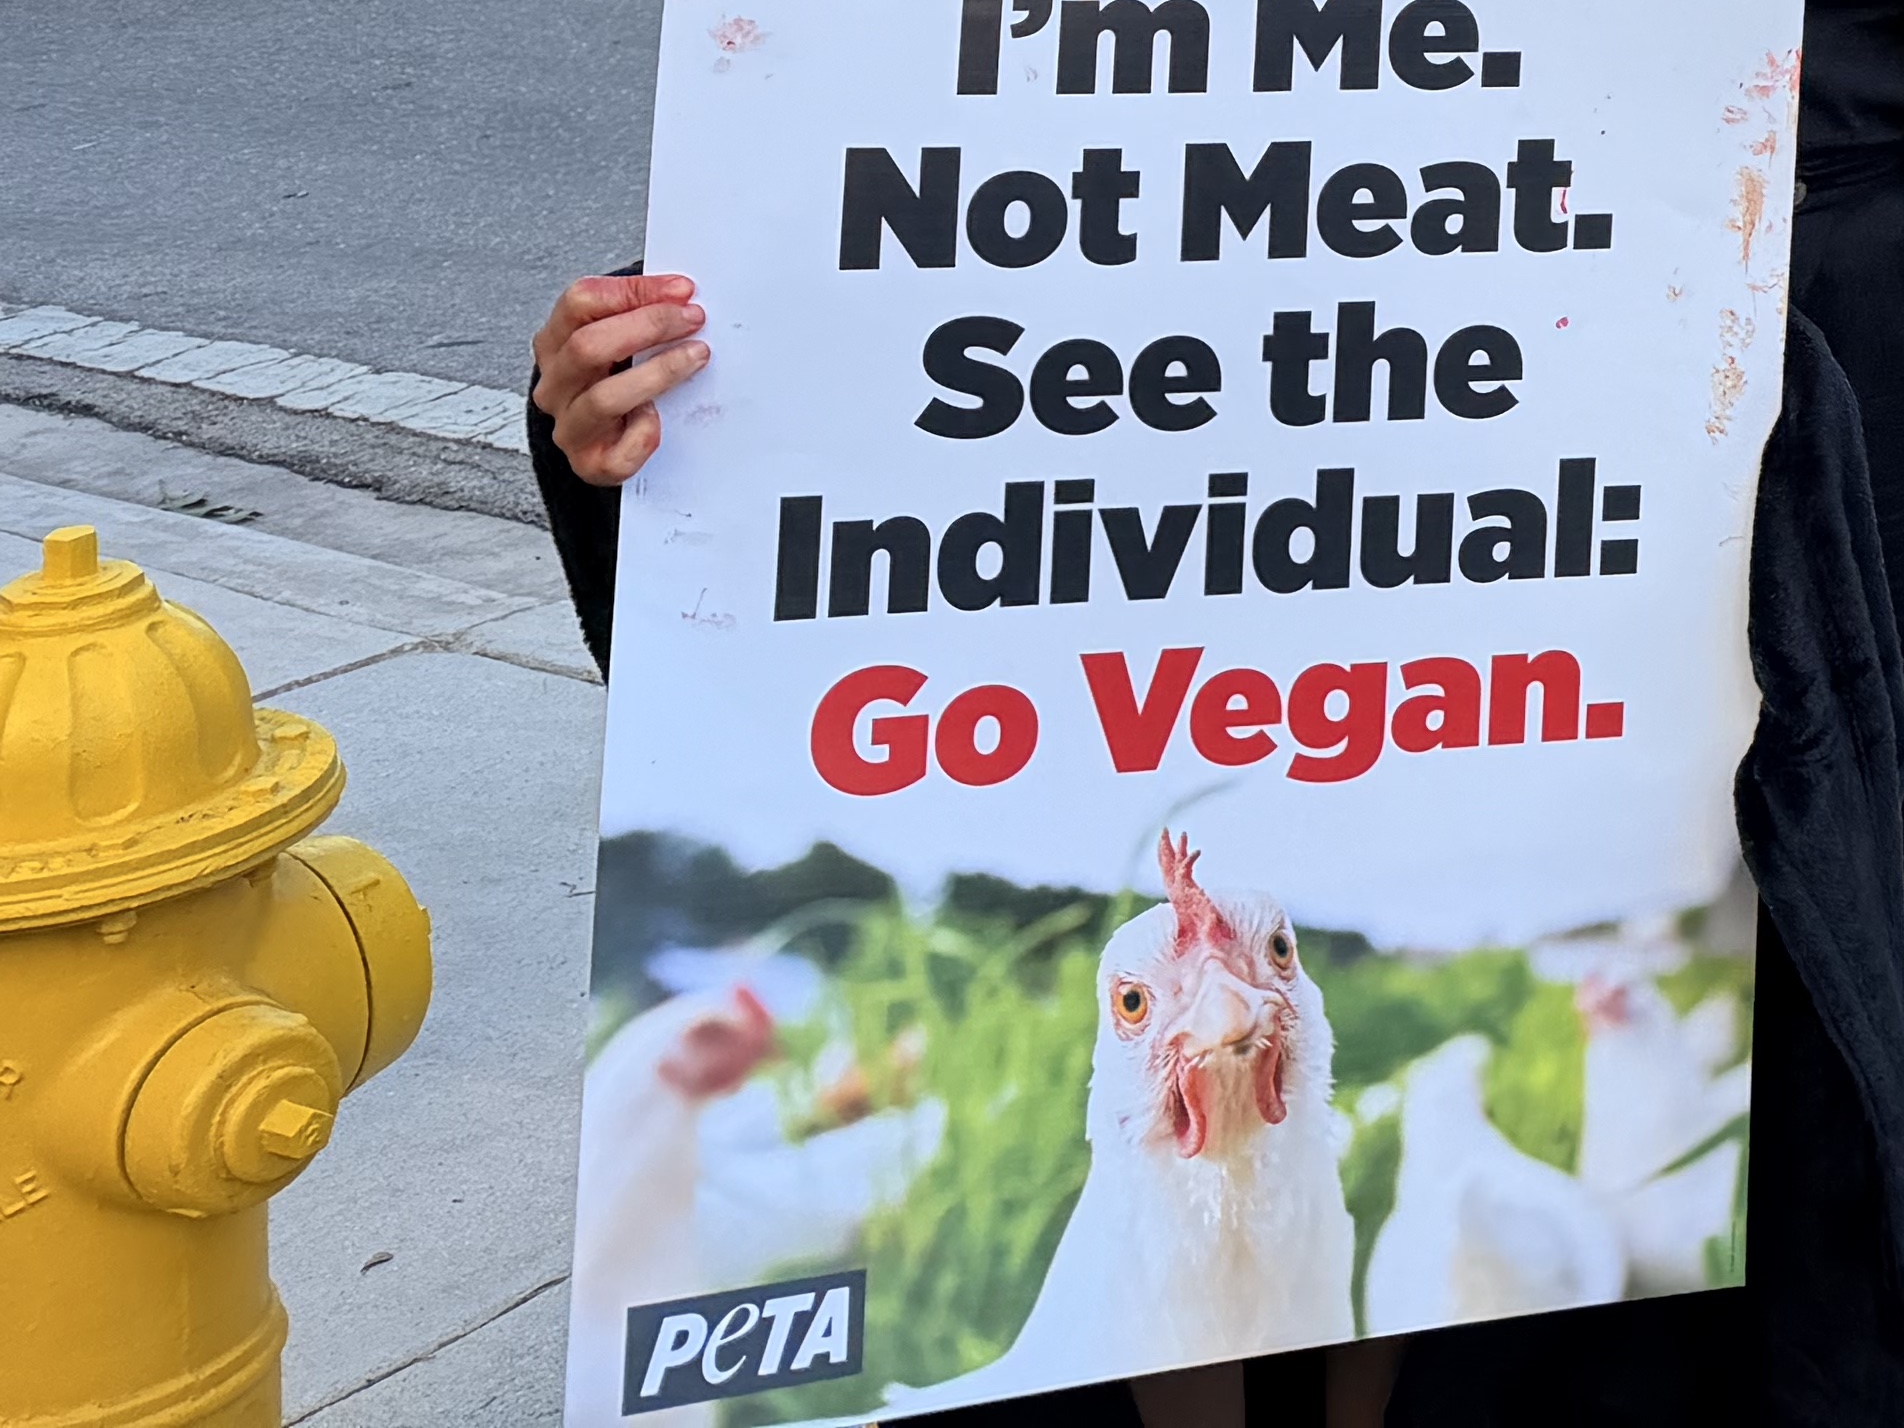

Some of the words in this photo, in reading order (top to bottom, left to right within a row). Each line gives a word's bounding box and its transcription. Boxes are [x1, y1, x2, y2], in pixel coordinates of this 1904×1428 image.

[839, 147, 1140, 270] Not
[1181, 139, 1612, 261] Meat.
[914, 316, 1221, 439] See
[1262, 301, 1522, 426] the
[774, 458, 1641, 621] Individual:
[812, 667, 1037, 796] Go
[1083, 649, 1623, 782] Vegan.
